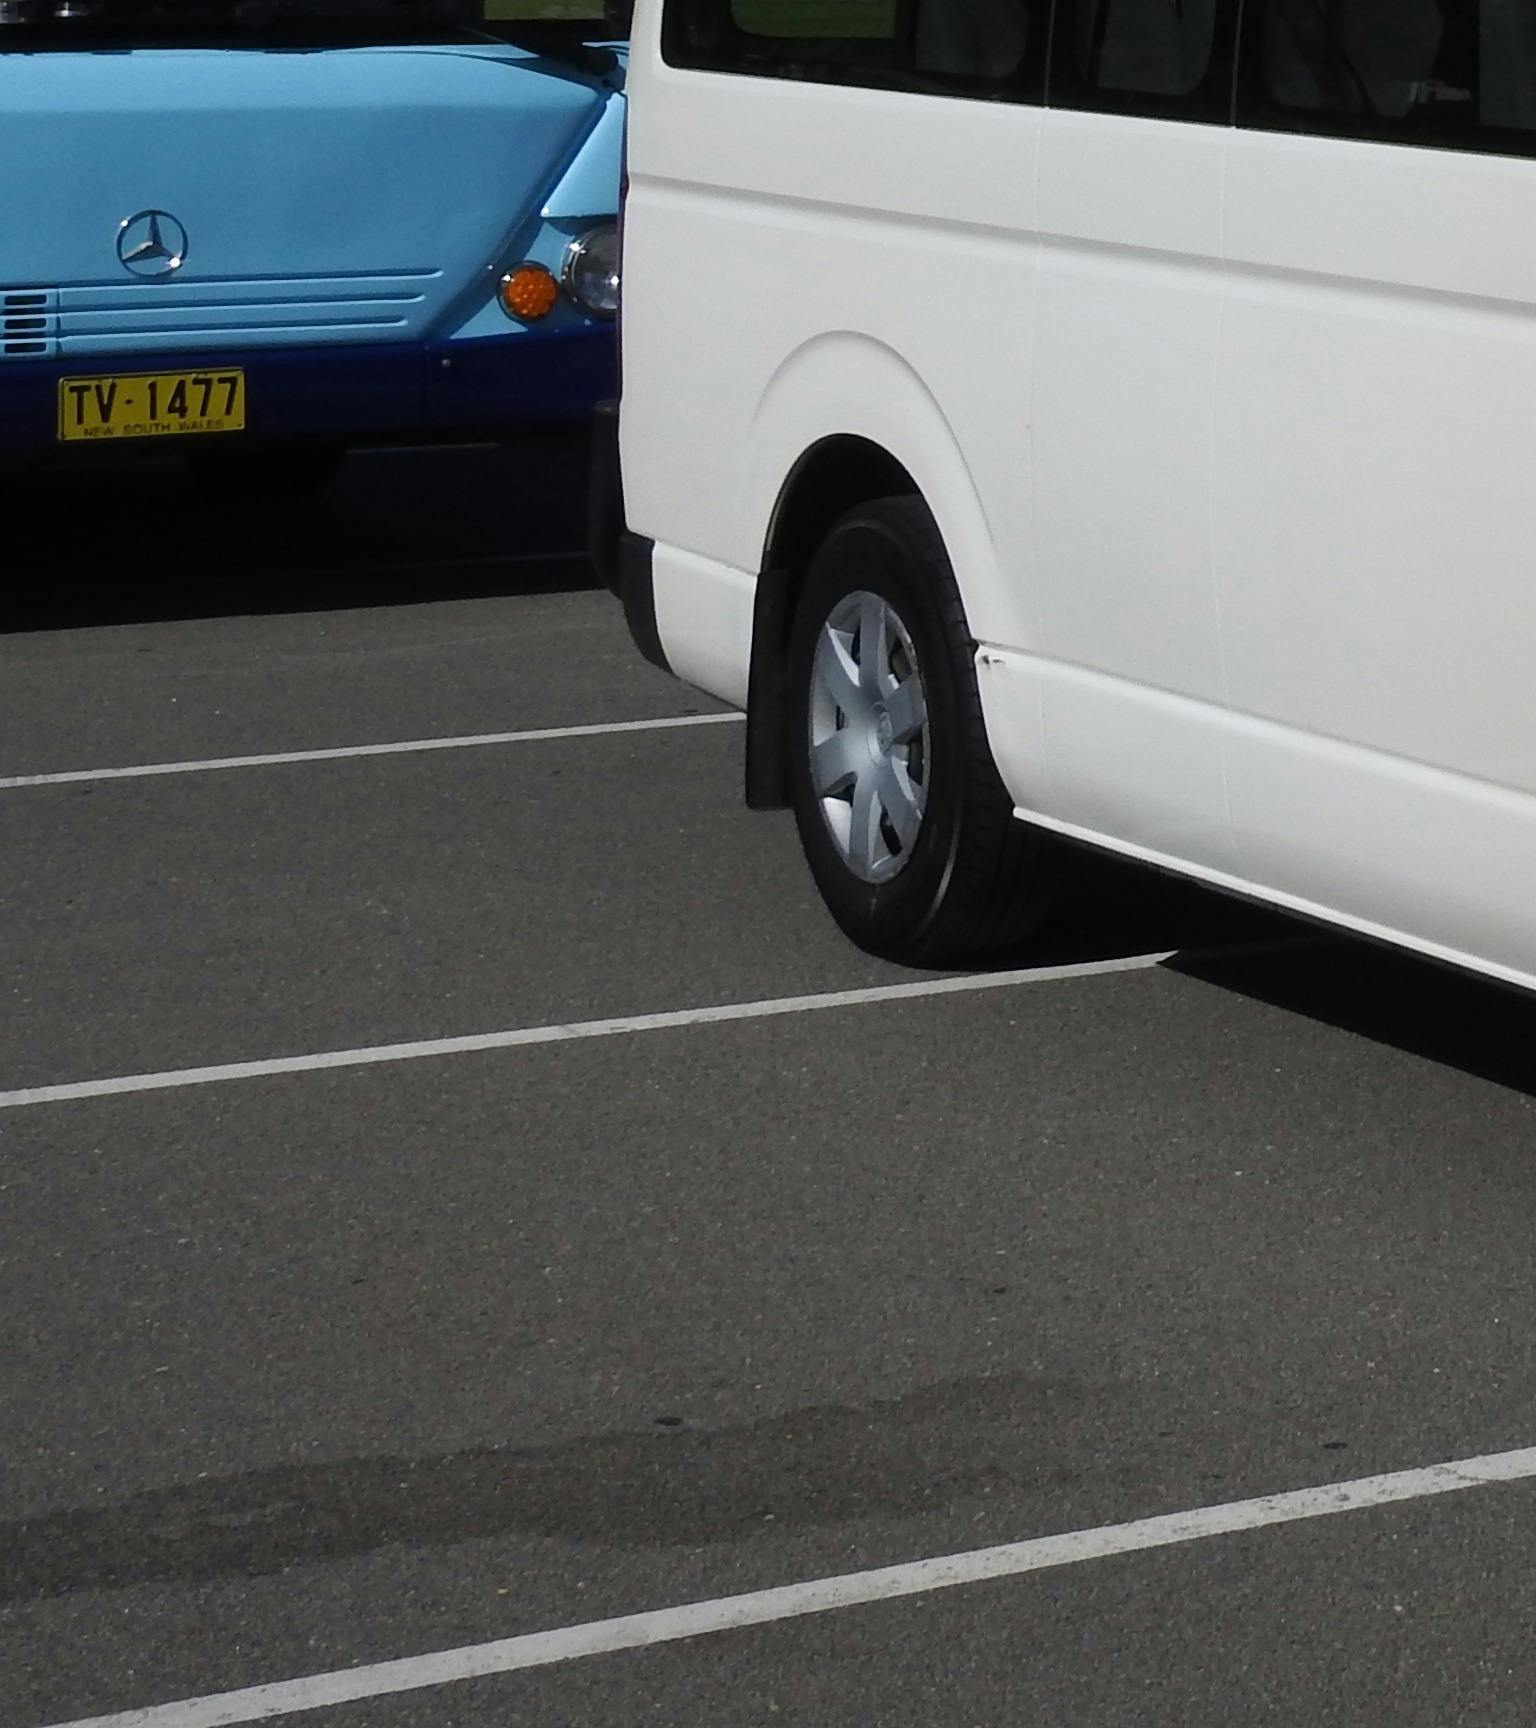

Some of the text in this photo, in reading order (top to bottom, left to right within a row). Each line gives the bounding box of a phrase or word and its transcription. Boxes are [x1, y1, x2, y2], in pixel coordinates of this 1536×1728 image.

[83, 418, 224, 437] NEW SOUTH WALES
